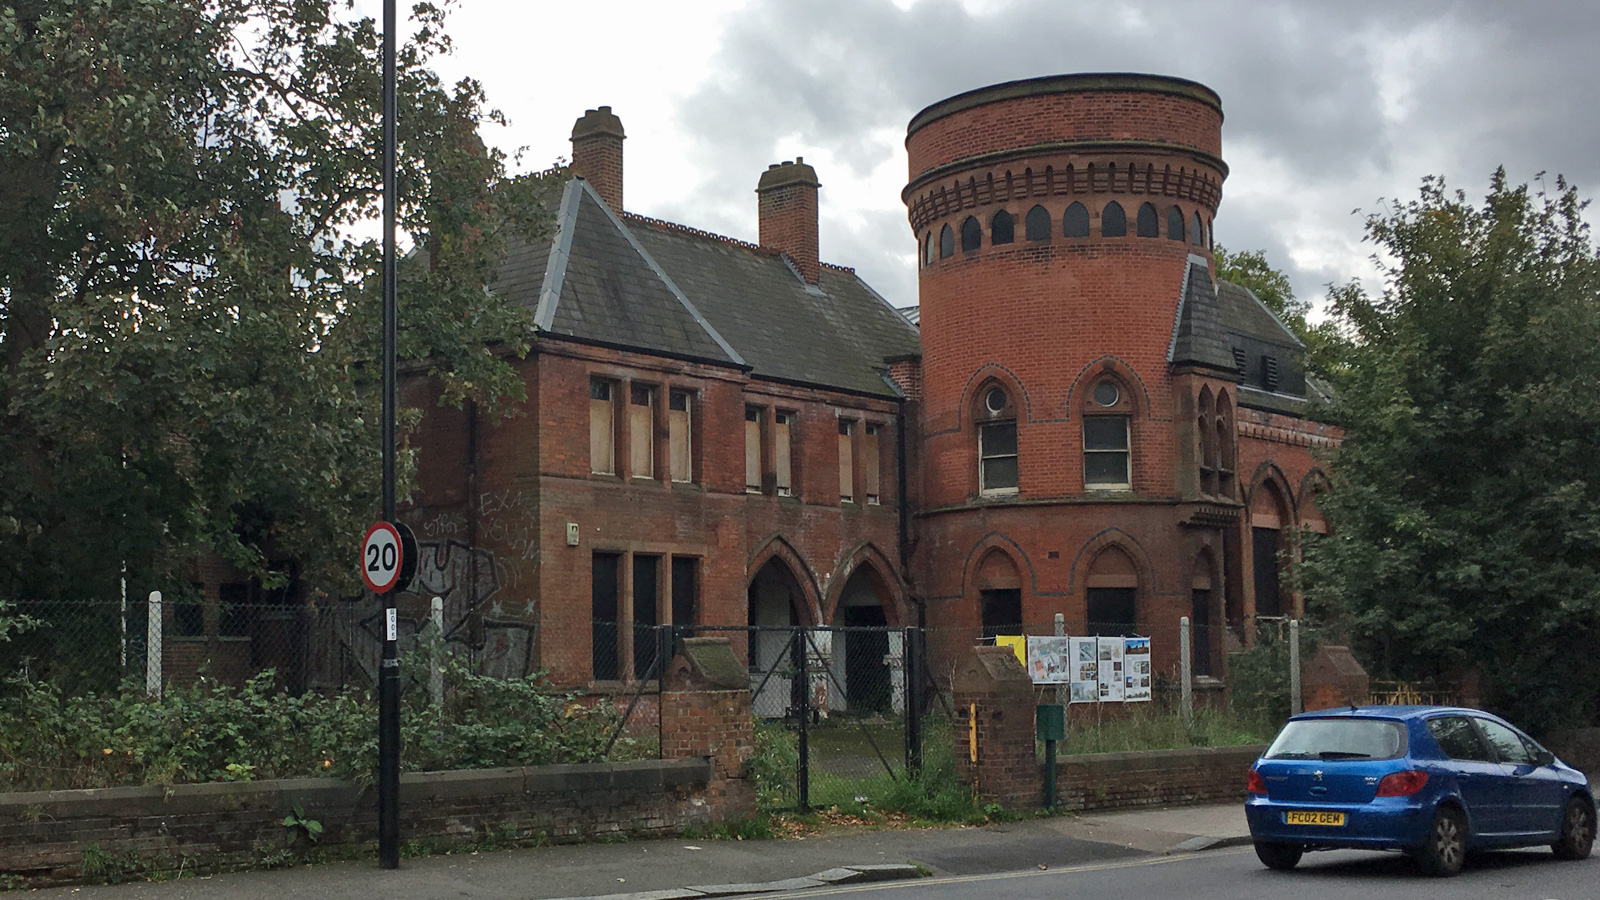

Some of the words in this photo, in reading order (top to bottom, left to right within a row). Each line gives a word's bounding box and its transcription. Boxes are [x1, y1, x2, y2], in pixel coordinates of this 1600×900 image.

[367, 542, 396, 572] 20
[1291, 813, 1318, 823] FC02
[1319, 813, 1340, 824] GEM
